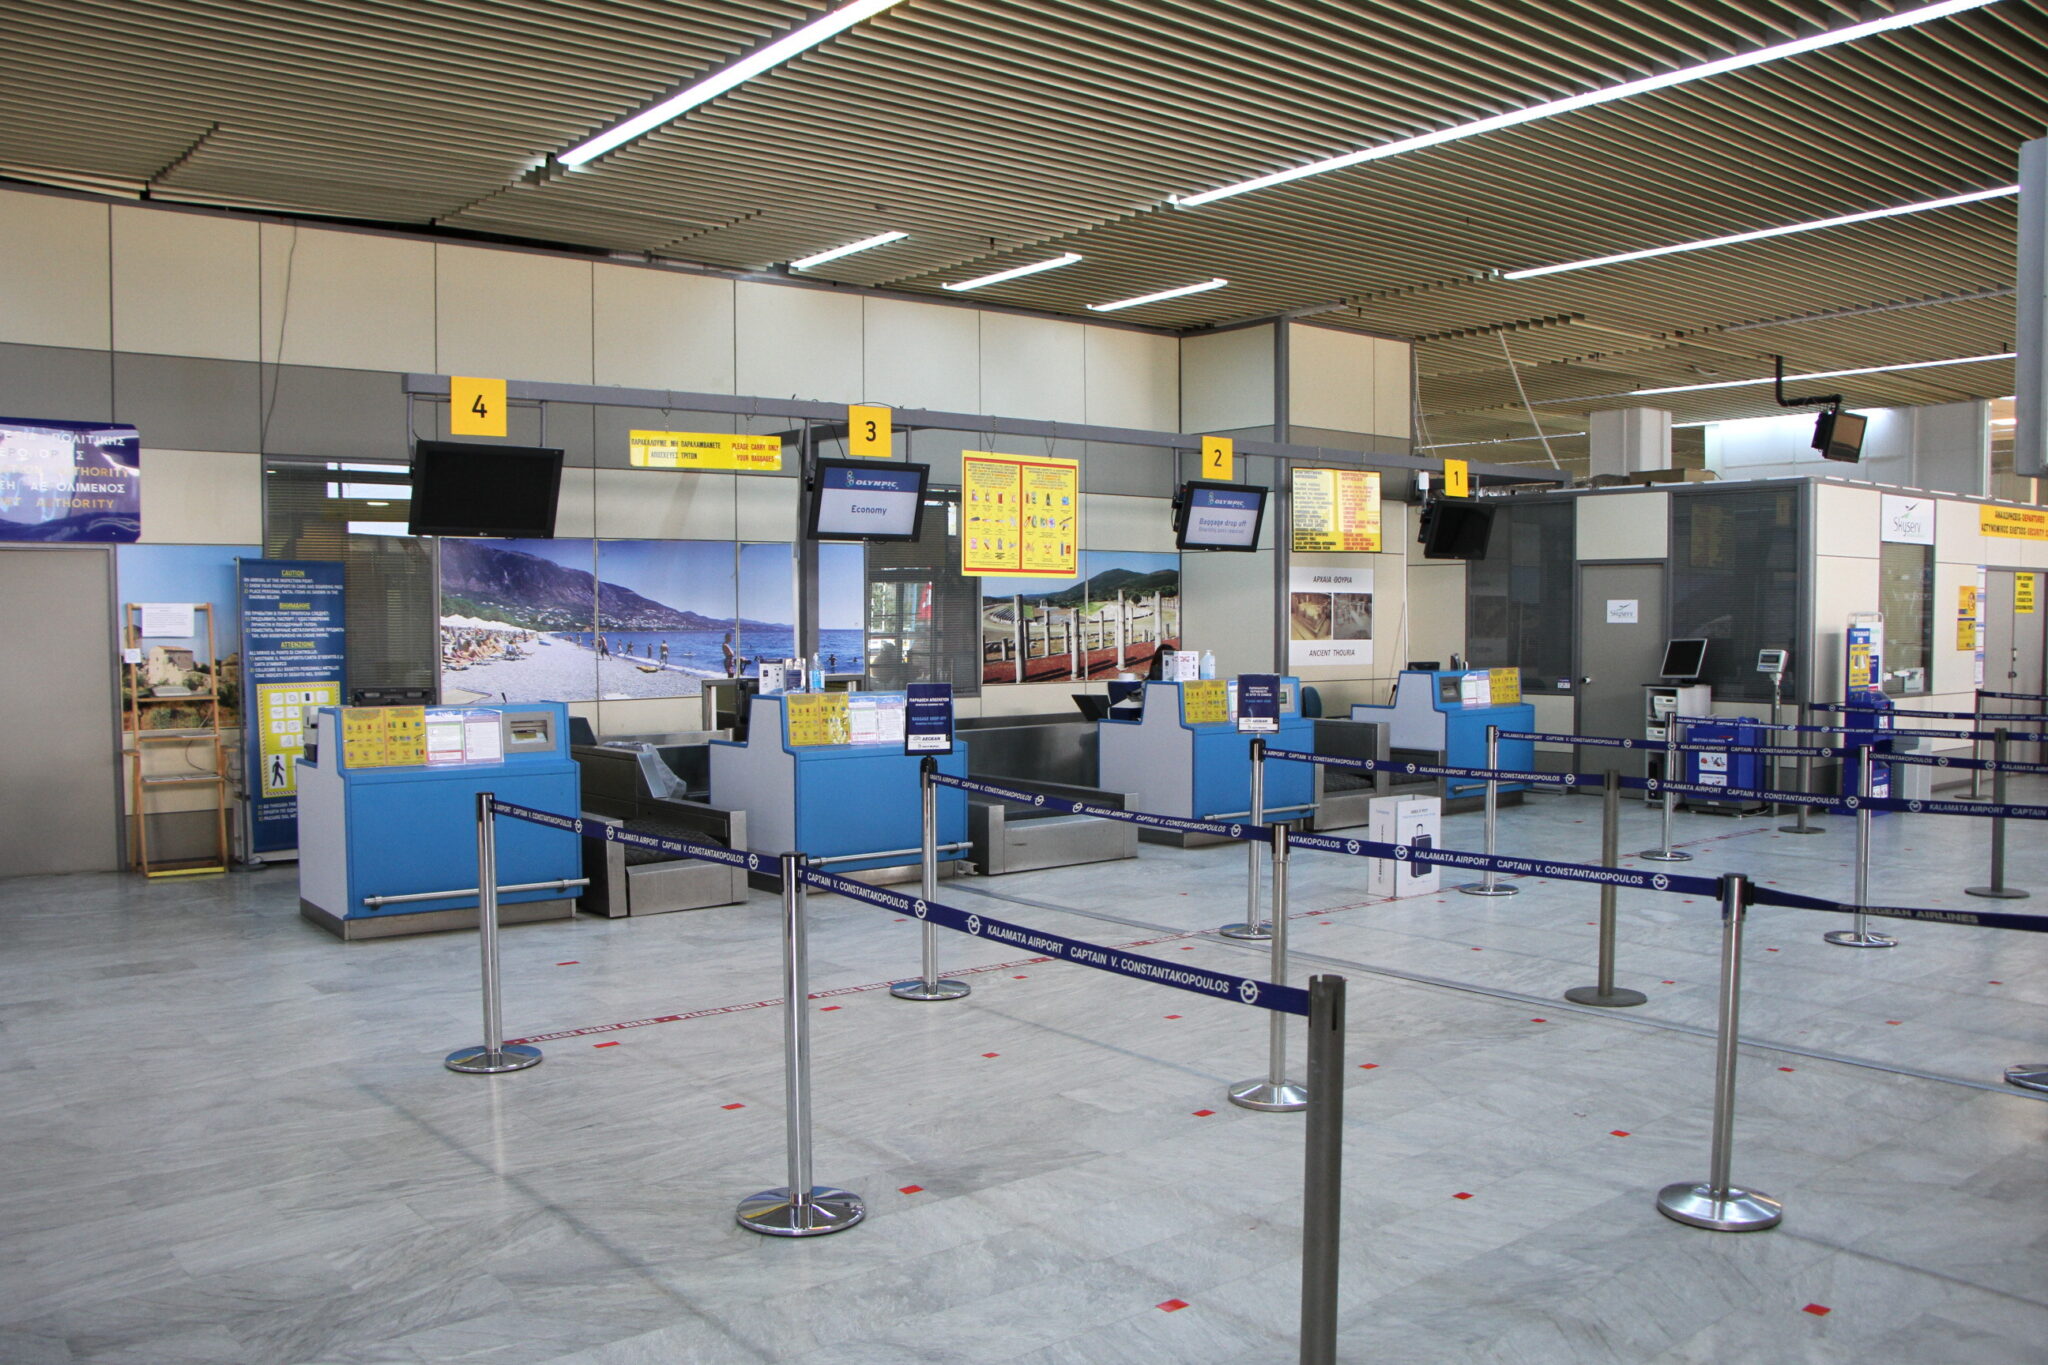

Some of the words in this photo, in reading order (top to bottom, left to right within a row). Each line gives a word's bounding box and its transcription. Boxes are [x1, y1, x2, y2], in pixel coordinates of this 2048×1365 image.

[472, 394, 488, 418] 4
[866, 420, 876, 442] 3
[1214, 449, 1222, 466] 2
[1454, 471, 1459, 486] 1
[31, 482, 126, 494] ΑΕΟΛΙΜΕΝΟΣ
[852, 505, 887, 515] Economy
[1663, 782, 1694, 790] KALAMATA
[1695, 785, 1722, 793] AIRPORT
[1727, 789, 1754, 797] CAPTAIN
[1763, 792, 1840, 805] CONSTANTAKOPOULOS
[1085, 806, 1111, 815] KALAMATA
[1111, 810, 1134, 819] AIRPORT
[1136, 815, 1158, 824] CAPTAIN
[1970, 805, 2004, 814] AIRPORT
[2011, 808, 2047, 816] CAPTAIN
[618, 832, 639, 842] KALAMATA
[639, 836, 658, 846] AIRPORT
[662, 841, 681, 851] CAPTAIN
[689, 847, 744, 863] CONSTANTAKOPOULOS
[1288, 835, 1340, 849] ANTAKOPOULOS
[1415, 850, 1454, 863] KALAMATA
[1455, 855, 1490, 867] AIRPORT
[1497, 860, 1532, 871] CAPTAIN
[1535, 864, 1543, 873] V.
[1544, 865, 1643, 885] CONSTANTAKOPOULOS
[807, 873, 831, 886] CAPTAIN
[833, 880, 838, 889] V.
[840, 882, 908, 910] CONSTANTAKOPOULOS
[1860, 907, 1913, 918] AEGEAN
[1916, 911, 1979, 924] AIRLINES
[987, 924, 1027, 944] KALAMATA
[1028, 935, 1064, 954] AIRPORT
[1070, 946, 1107, 964] CAPTAIN
[1110, 957, 1119, 967] V.
[1121, 958, 1230, 993] CONSTANTAKOPOULOS
